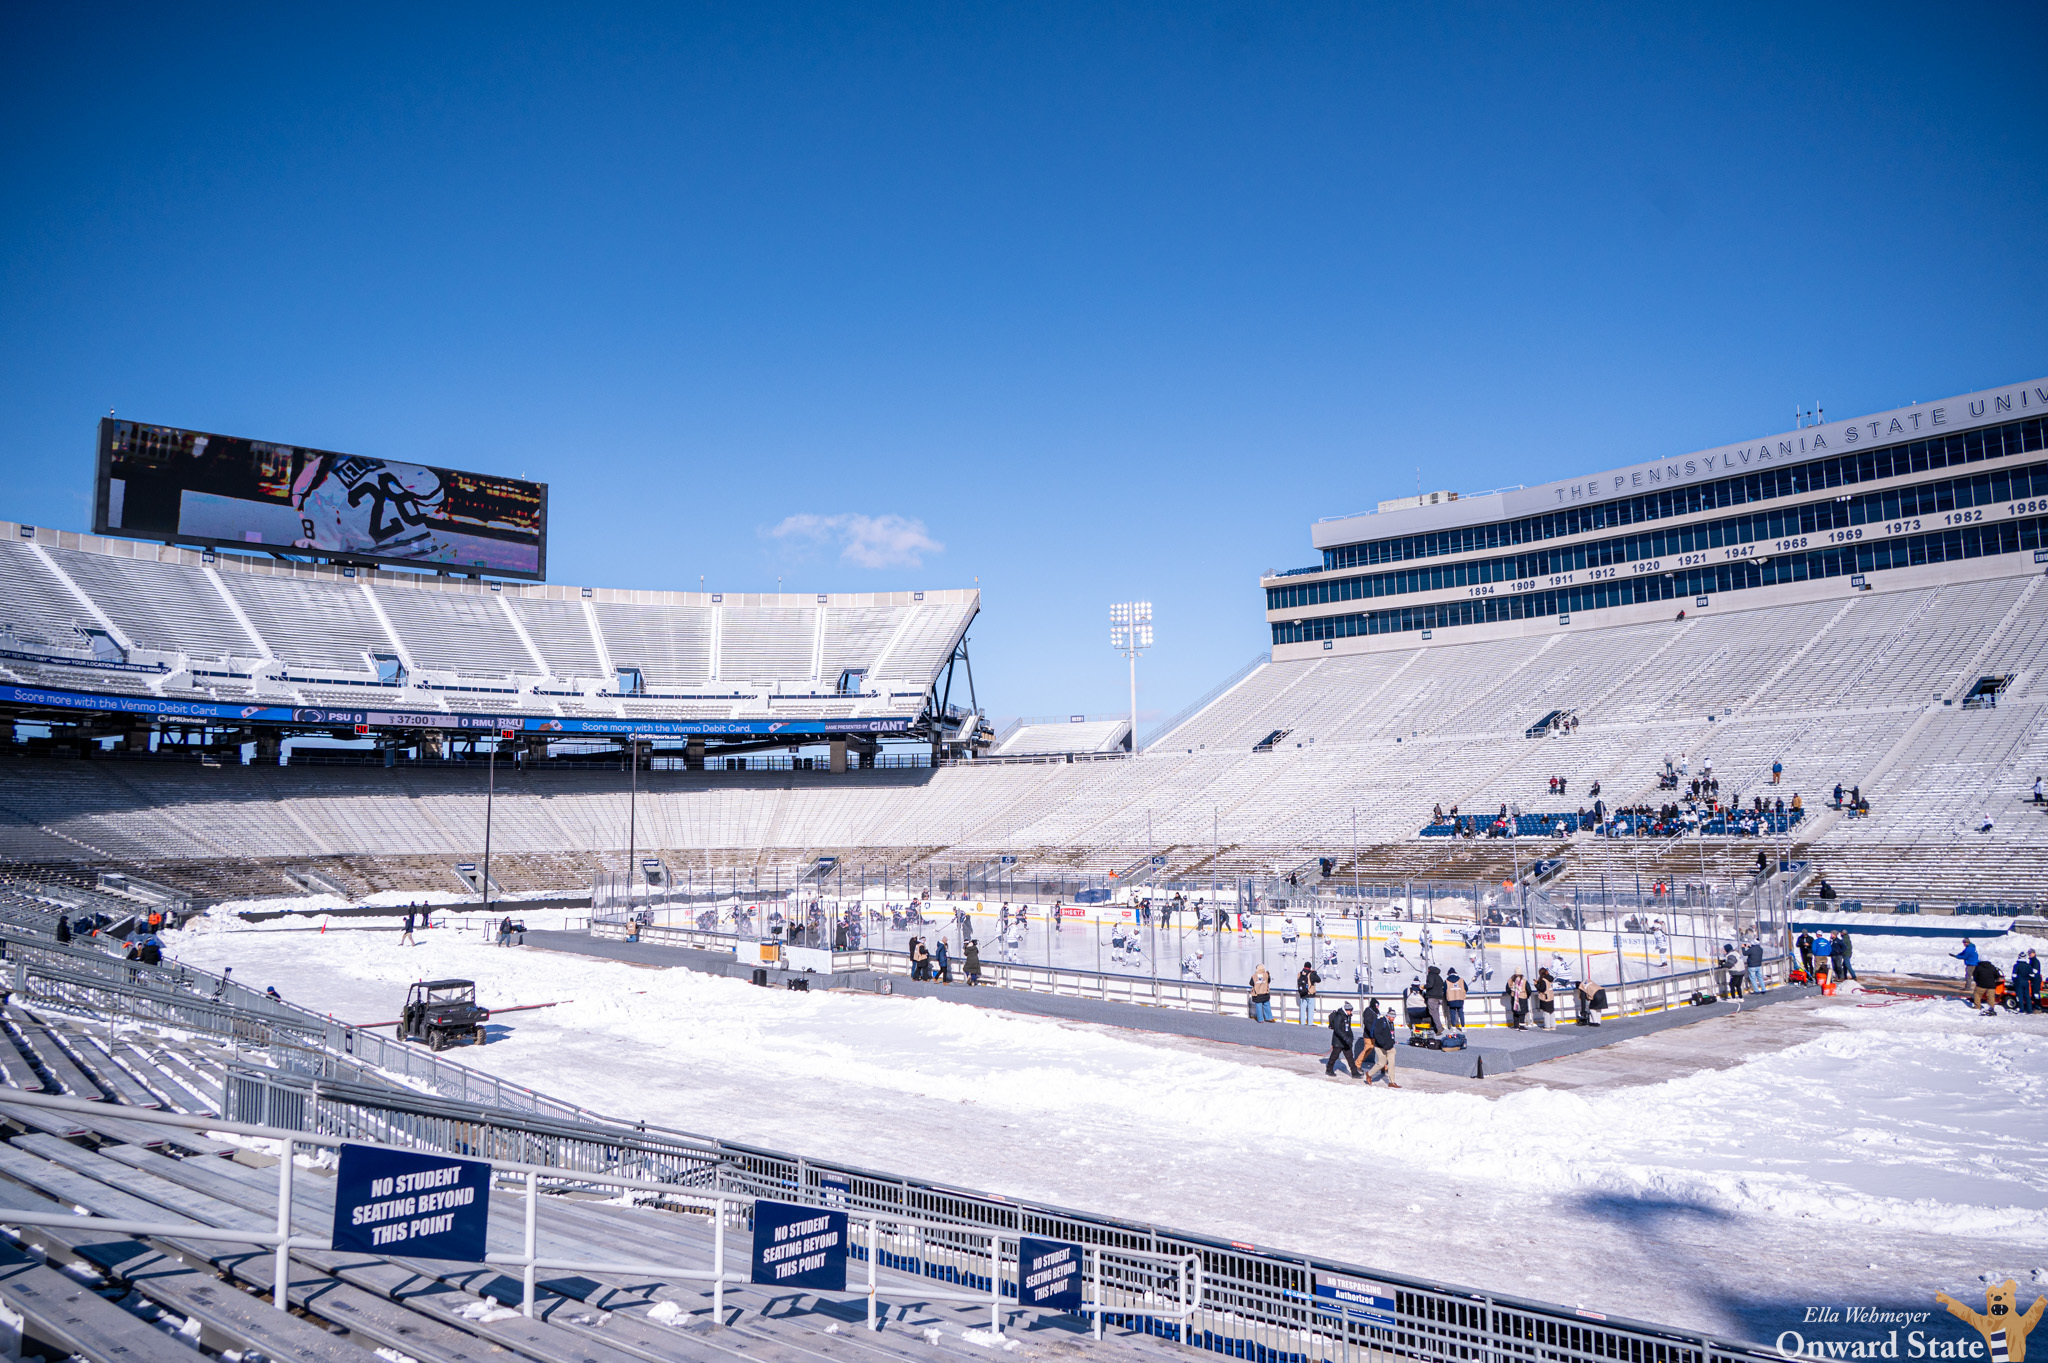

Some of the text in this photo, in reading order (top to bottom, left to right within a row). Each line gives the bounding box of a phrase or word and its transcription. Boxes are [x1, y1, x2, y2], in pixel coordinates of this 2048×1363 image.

[1555, 387, 2048, 502] THE PENNSYLVANIA STATE UNIV
[302, 519, 315, 540] 8
[1469, 499, 2048, 597] 1894 1909 1911 1912 1920 1921 1947 1968 1969 1973 1982 1986
[14, 689, 219, 716] Score more with the Venmo Debit Card.
[328, 712, 362, 723] PSU 0
[397, 716, 429, 724] 37:00
[461, 718, 468, 727] 0
[472, 718, 494, 727] RMU
[582, 722, 751, 733] Score more with the Venmo Debit Card.
[870, 720, 904, 731] GIANT
[355, 725, 368, 734] 40
[502, 730, 514, 738] 40
[371, 1166, 462, 1198] NO STUDENT
[352, 1187, 475, 1225] SEATING BEYOND
[372, 1213, 455, 1246] THIS POINT
[774, 1215, 830, 1242] NO STUDENT
[763, 1231, 838, 1263] SEATING BEYOND
[775, 1252, 826, 1279] THIS POINT
[1033, 1247, 1070, 1270] NO STUDENT
[1026, 1261, 1076, 1288] SEATING BEYOND
[1034, 1279, 1068, 1301] THIS POINT
[1327, 1277, 1382, 1295] NO TRESPASSING
[1335, 1289, 1374, 1305] Authorized
